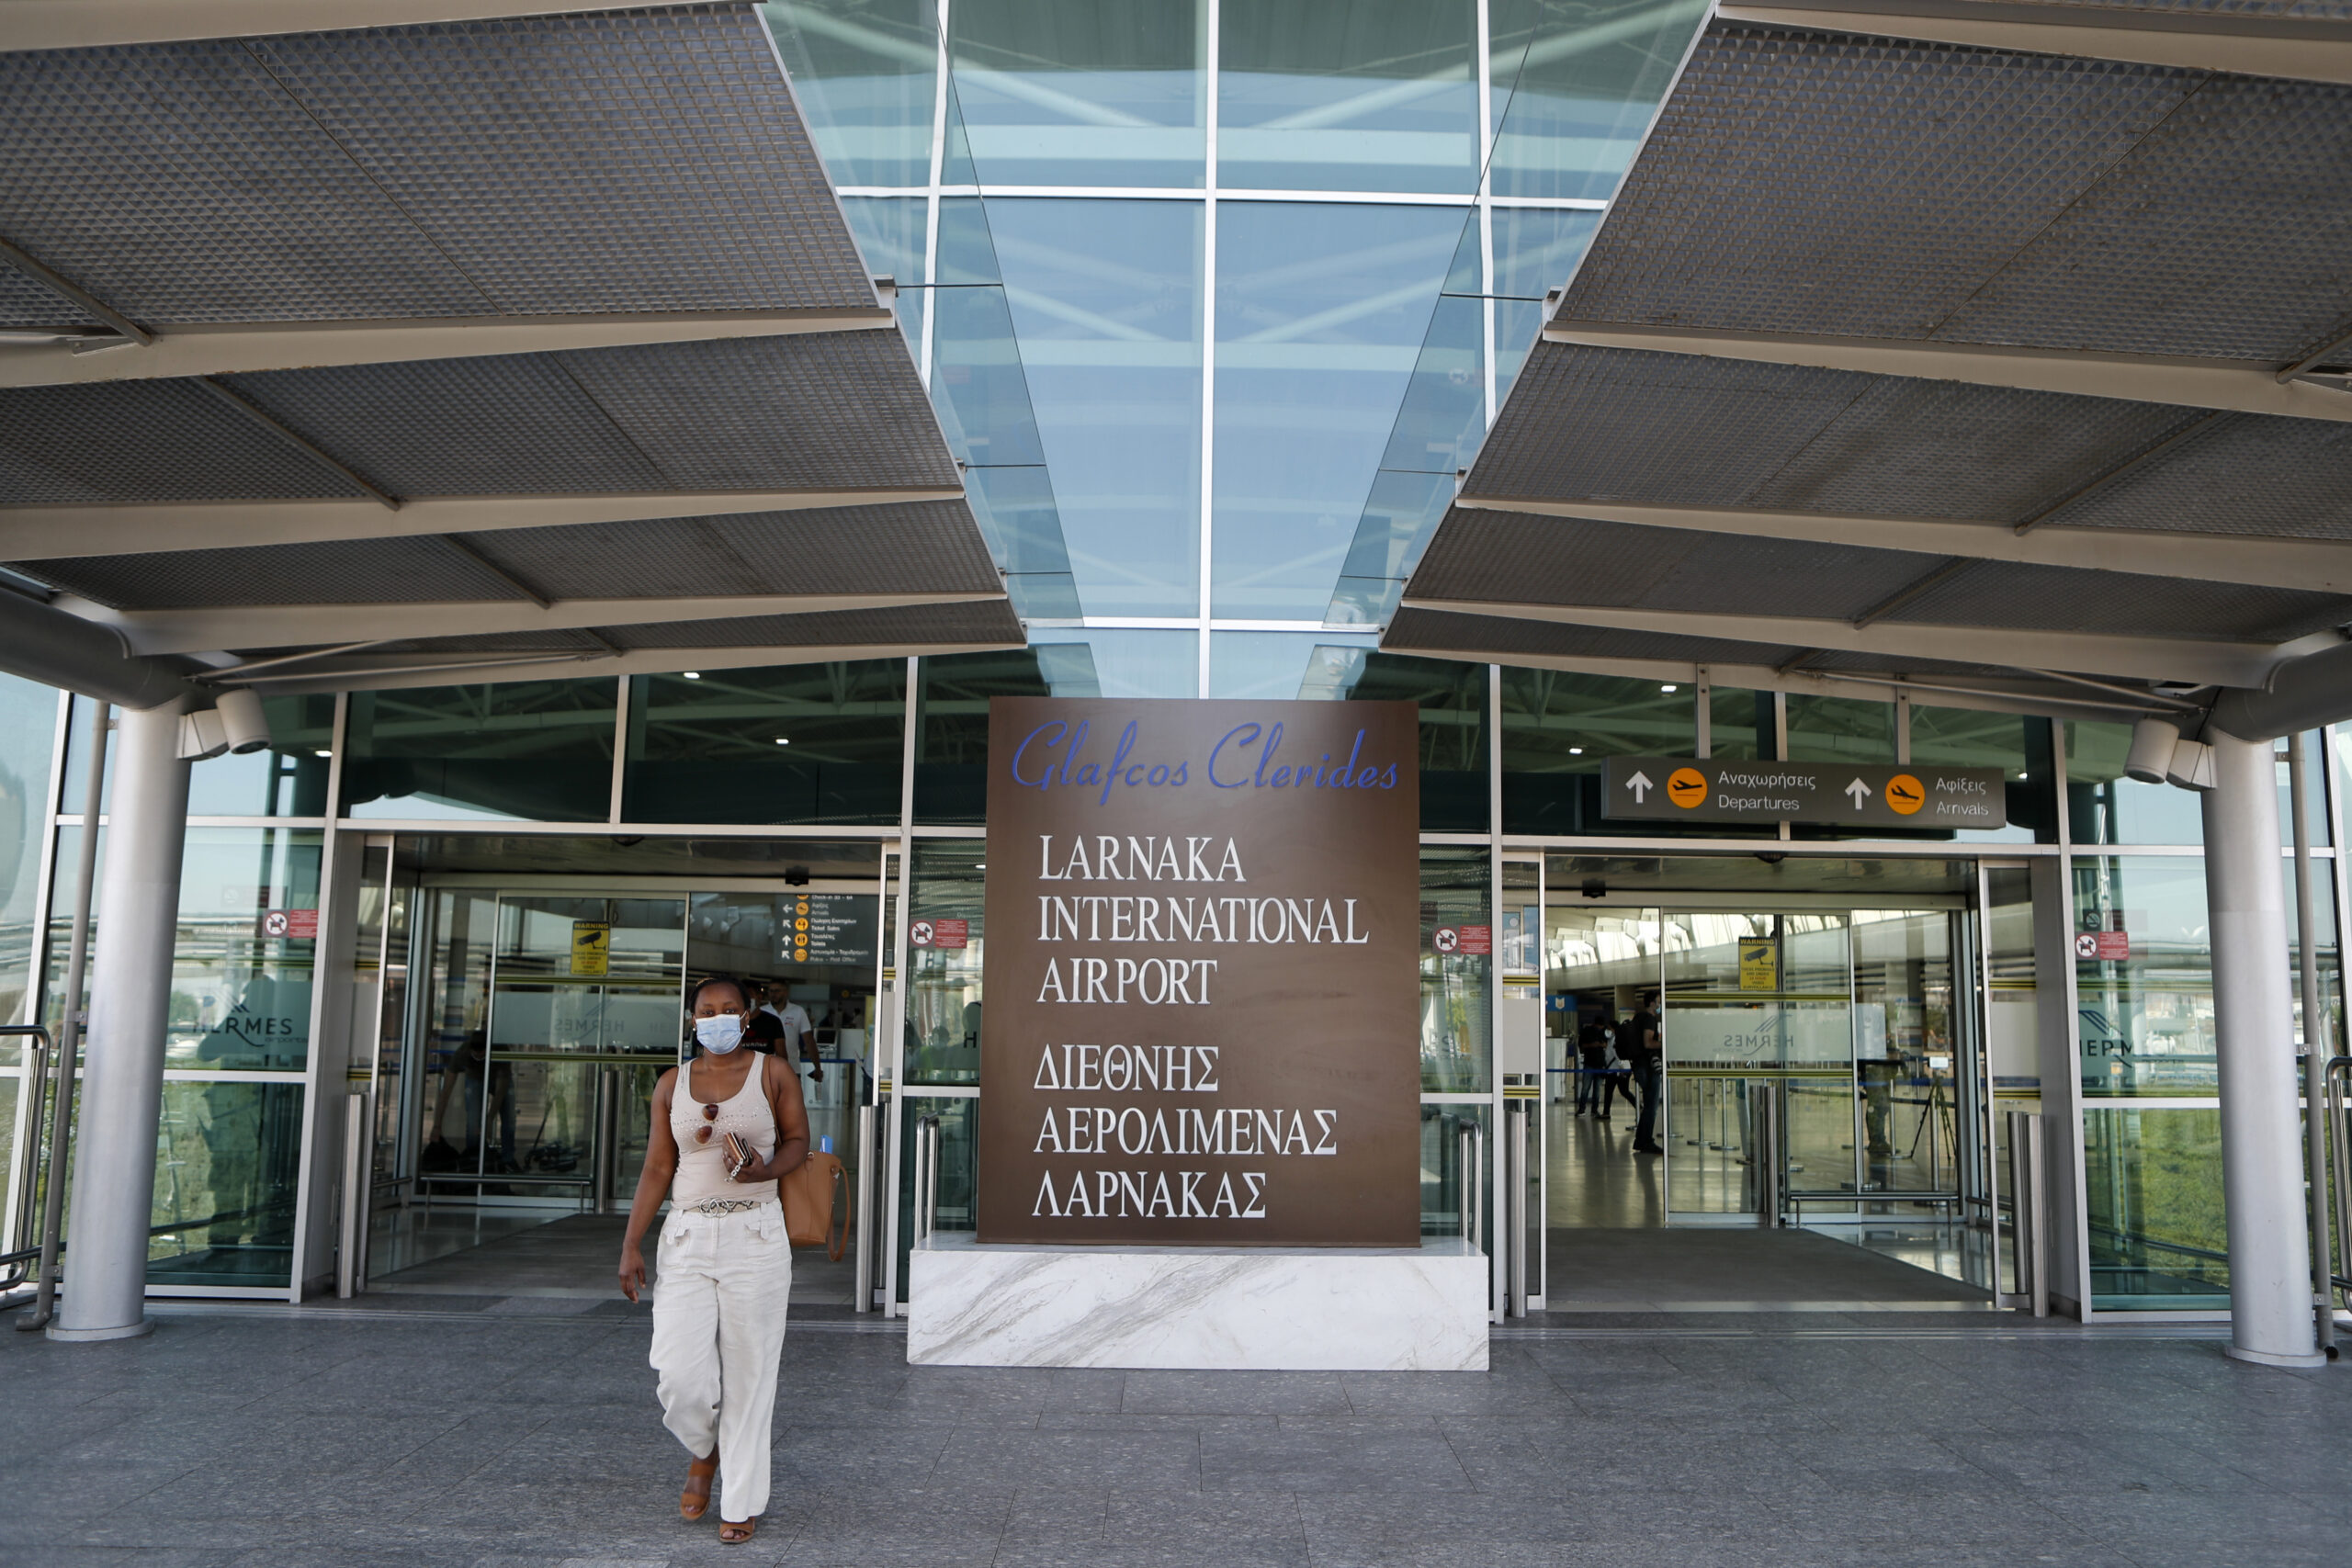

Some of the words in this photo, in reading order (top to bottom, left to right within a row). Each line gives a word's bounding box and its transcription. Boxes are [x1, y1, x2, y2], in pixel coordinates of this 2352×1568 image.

[1011, 719, 1190, 806] Glafcos
[1207, 721, 1397, 790] Clerides
[1718, 770, 1816, 790] Αναχωρήσεις
[1935, 776, 1987, 795] Αφίξεις
[1718, 794, 1800, 812] Departures
[1936, 800, 1989, 816] Arrivals
[1038, 834, 1246, 882] LARNAKA
[1037, 896, 1369, 944] INTERNATIONAL
[1036, 957, 1217, 1004] AIRPORT
[1034, 1043, 1219, 1091] ΔΙΕΘΝΗΣ
[1033, 1107, 1338, 1155] ΑΕΡΟΛΙΜΕΝΑΣ
[1032, 1169, 1266, 1219] ΛΑΡΝΑΚΑΣ
